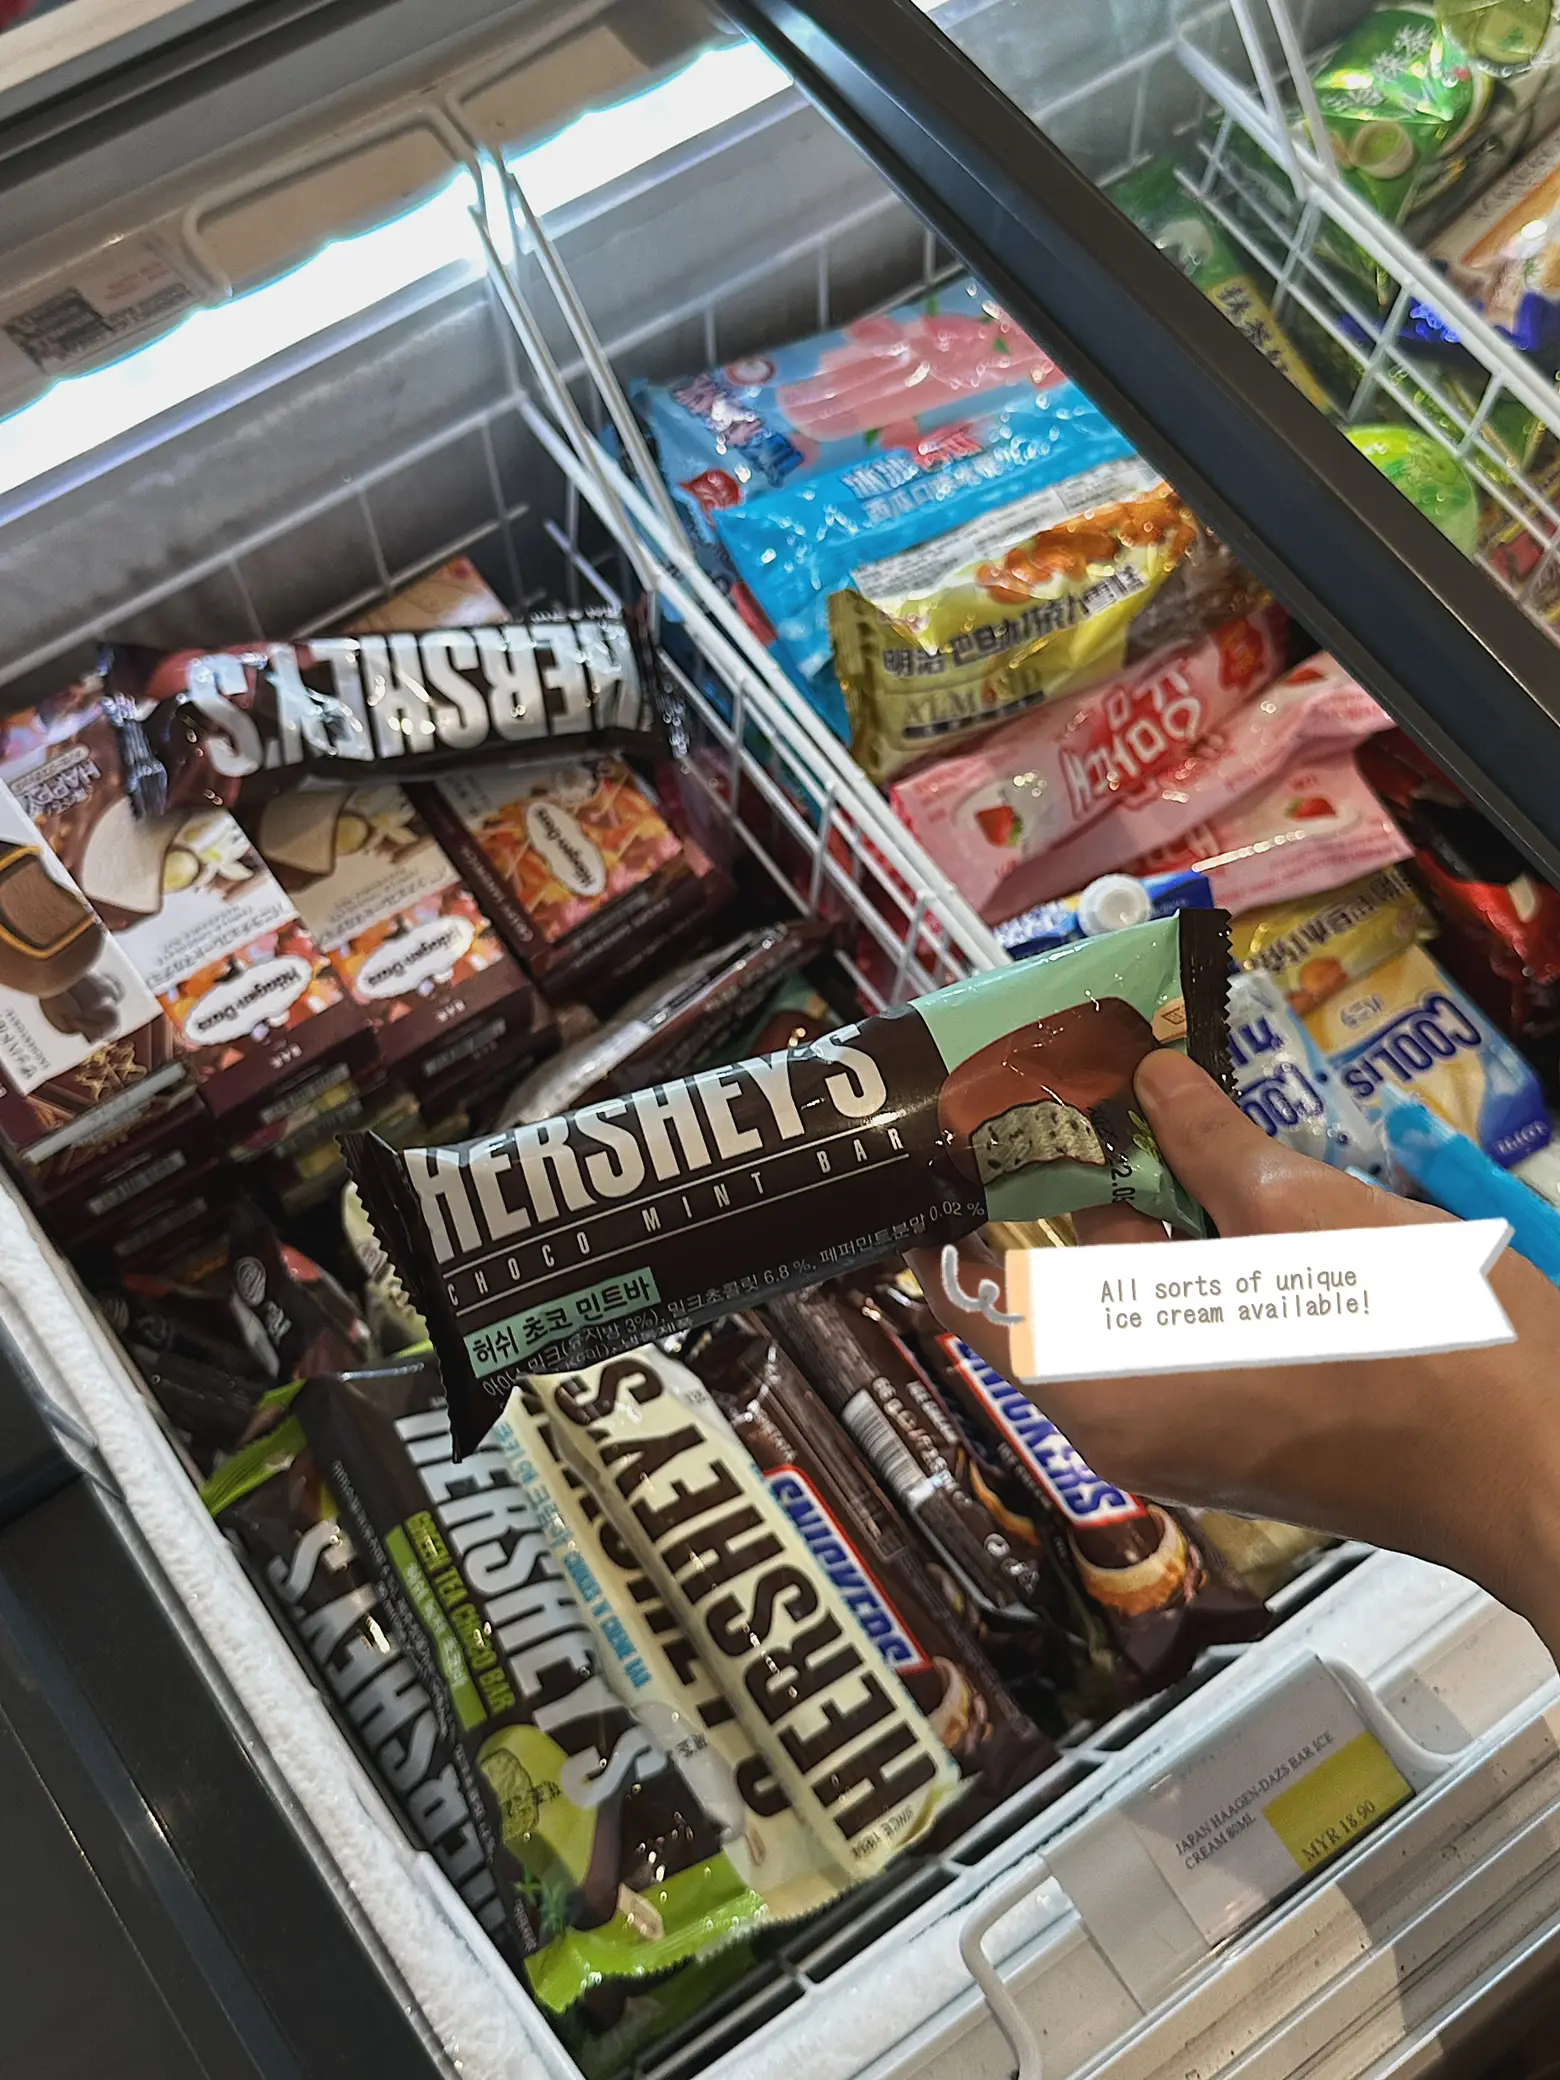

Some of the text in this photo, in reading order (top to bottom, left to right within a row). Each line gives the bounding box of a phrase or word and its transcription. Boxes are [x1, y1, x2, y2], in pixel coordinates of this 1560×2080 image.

[186, 622, 640, 778] HERSHEY'S
[1241, 1060, 1327, 1139] COO
[1340, 993, 1482, 1102] COOLIS
[403, 1025, 888, 1265] HERSHEY'S
[445, 1124, 905, 1308] CHOCO MINT BAR
[761, 1261, 791, 1286] 6.8
[926, 1196, 966, 1224] 0.02
[964, 1196, 987, 1220] %
[469, 1273, 654, 1368] 허쉬 초코 민트바
[392, 1401, 671, 1812] HERSHEYS
[431, 1567, 470, 1608] TEA
[476, 1666, 518, 1716] BAR
[554, 1357, 938, 1840] HERSHEY'S
[1172, 1729, 1334, 1856] JAPAN HAAGEN-DAZS BAR ICE
[1182, 1830, 1229, 1871] CREAM
[1300, 1825, 1342, 1862] MYR
